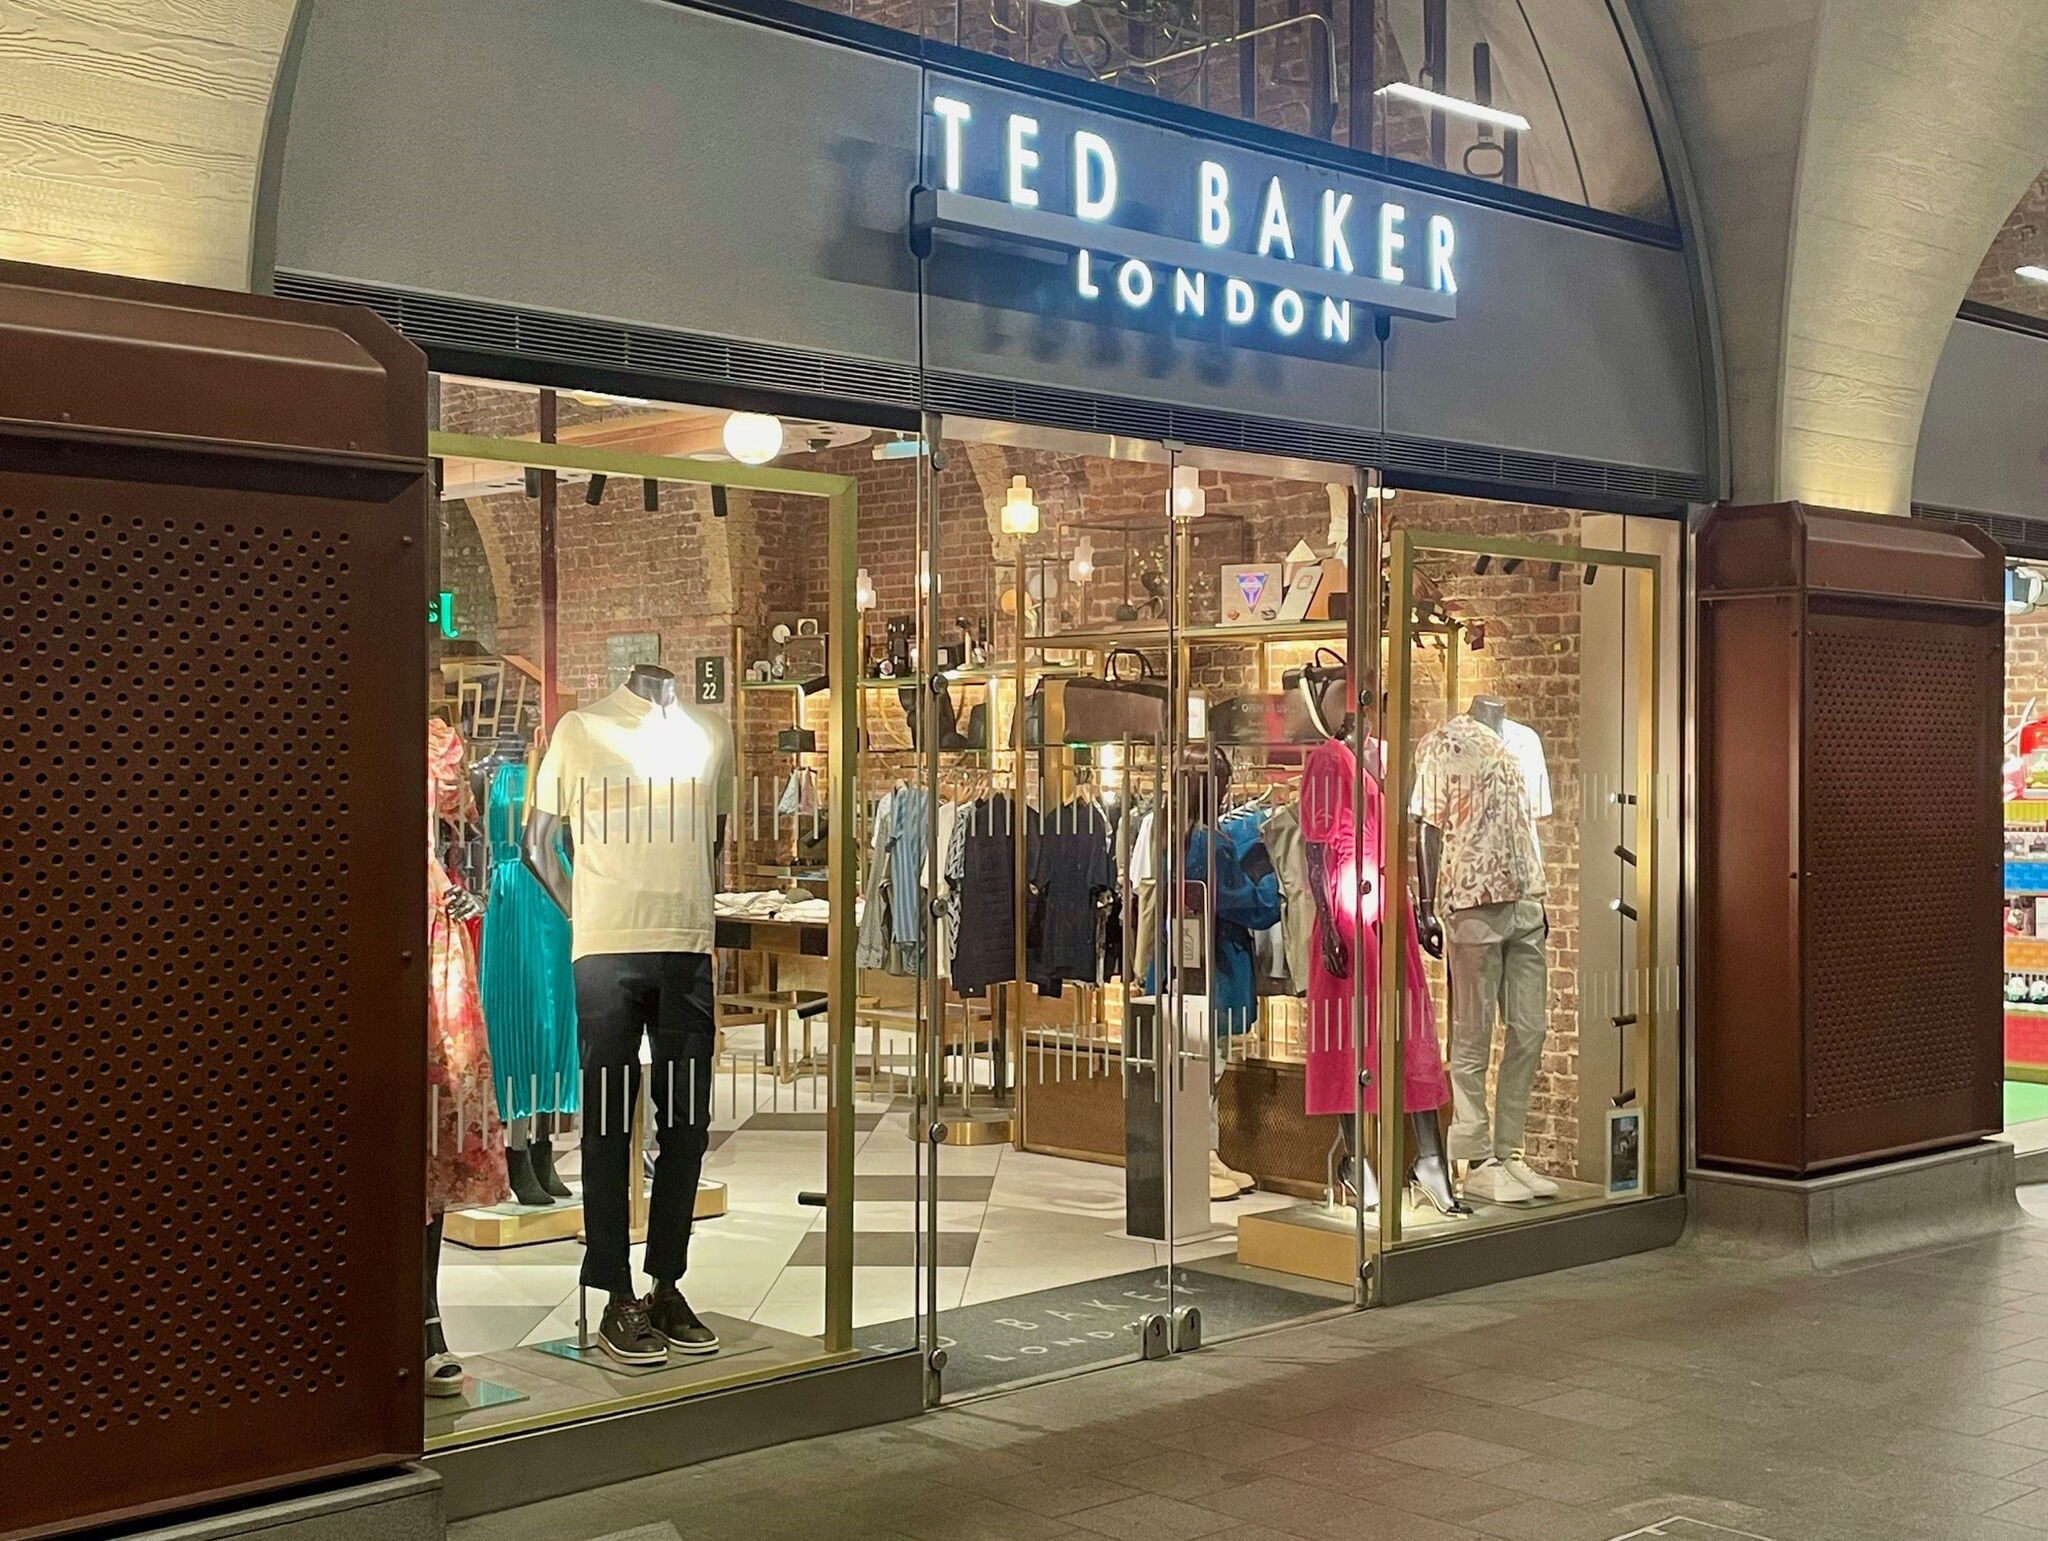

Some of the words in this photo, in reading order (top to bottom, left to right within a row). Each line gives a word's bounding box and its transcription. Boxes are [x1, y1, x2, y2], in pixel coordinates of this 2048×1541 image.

[933, 95, 1118, 223] TED
[1200, 160, 1459, 296] BAKER
[1078, 249, 1351, 343] LONDON
[702, 682, 717, 700] 22
[705, 661, 714, 678] E
